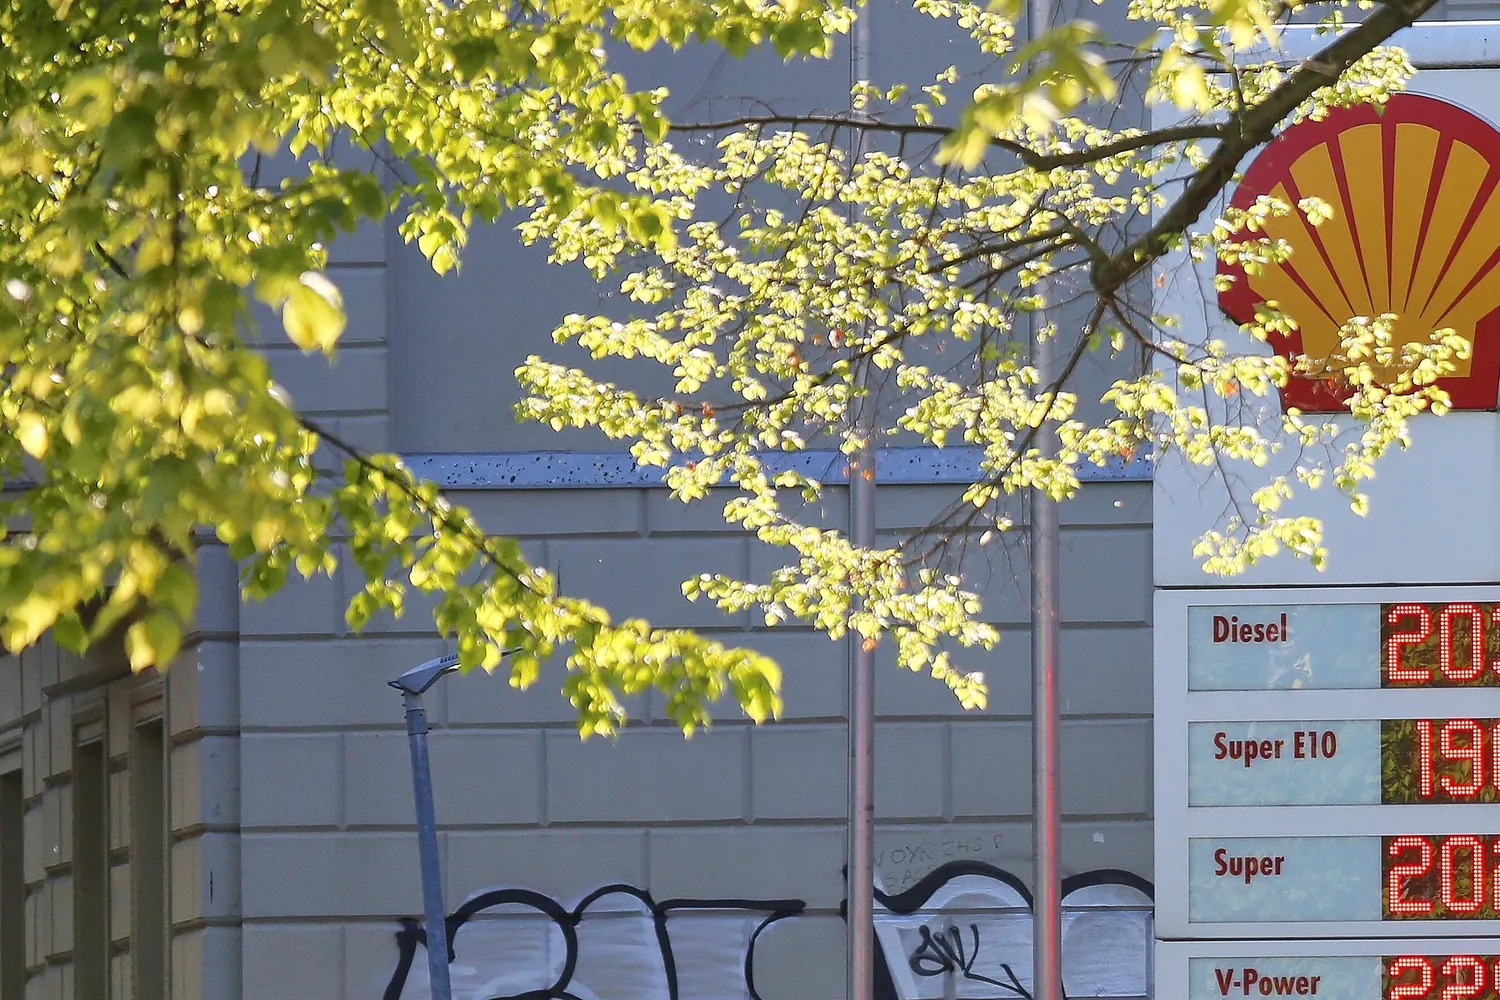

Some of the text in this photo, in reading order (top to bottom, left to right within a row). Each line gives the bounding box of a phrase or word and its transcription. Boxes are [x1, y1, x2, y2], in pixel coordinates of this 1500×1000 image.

[1212, 612, 1288, 643] Diesel
[1213, 730, 1337, 767] Super E10
[1214, 848, 1285, 884] Super
[1215, 968, 1321, 996] V-Power
